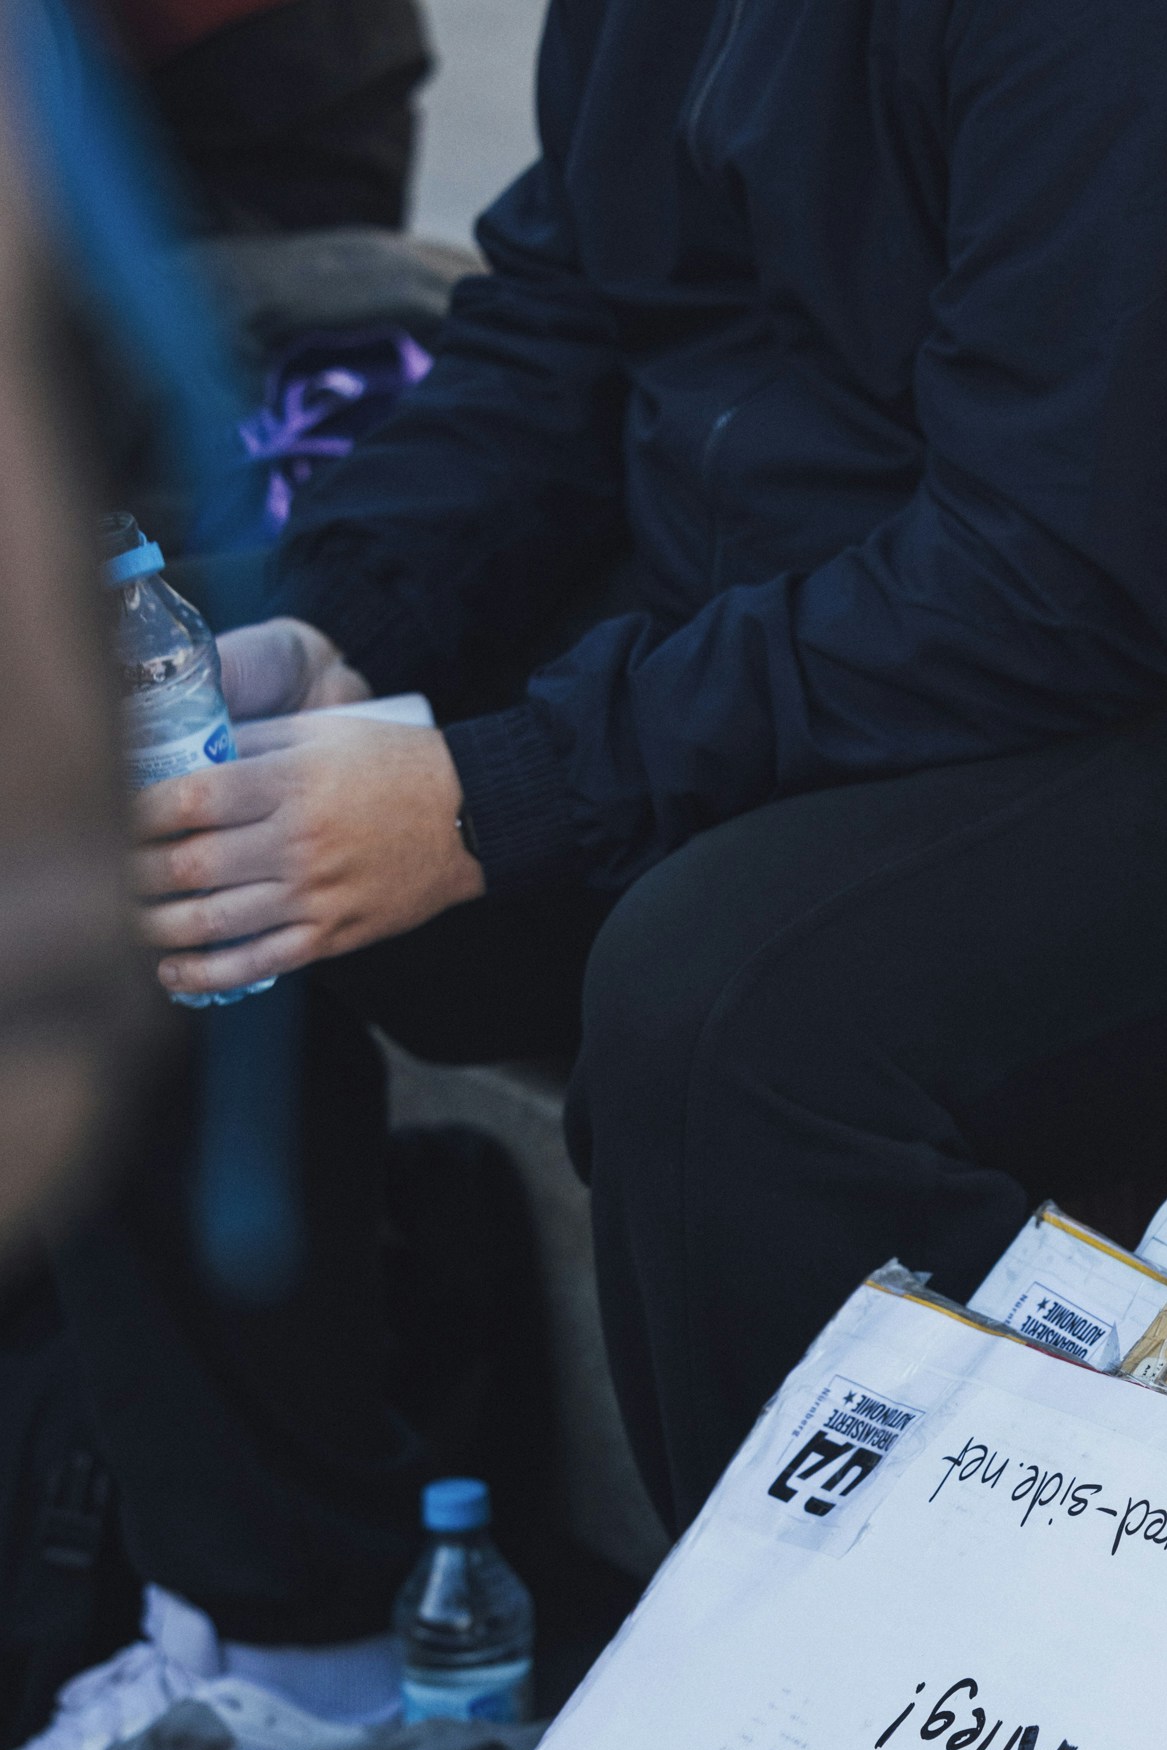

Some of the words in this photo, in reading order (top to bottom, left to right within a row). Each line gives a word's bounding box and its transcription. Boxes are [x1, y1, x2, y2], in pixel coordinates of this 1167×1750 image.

[1042, 1301, 1106, 1347] AUTONOMIE
[792, 1387, 831, 1437] Nürnberg
[851, 1394, 916, 1431] AUTONOMIE
